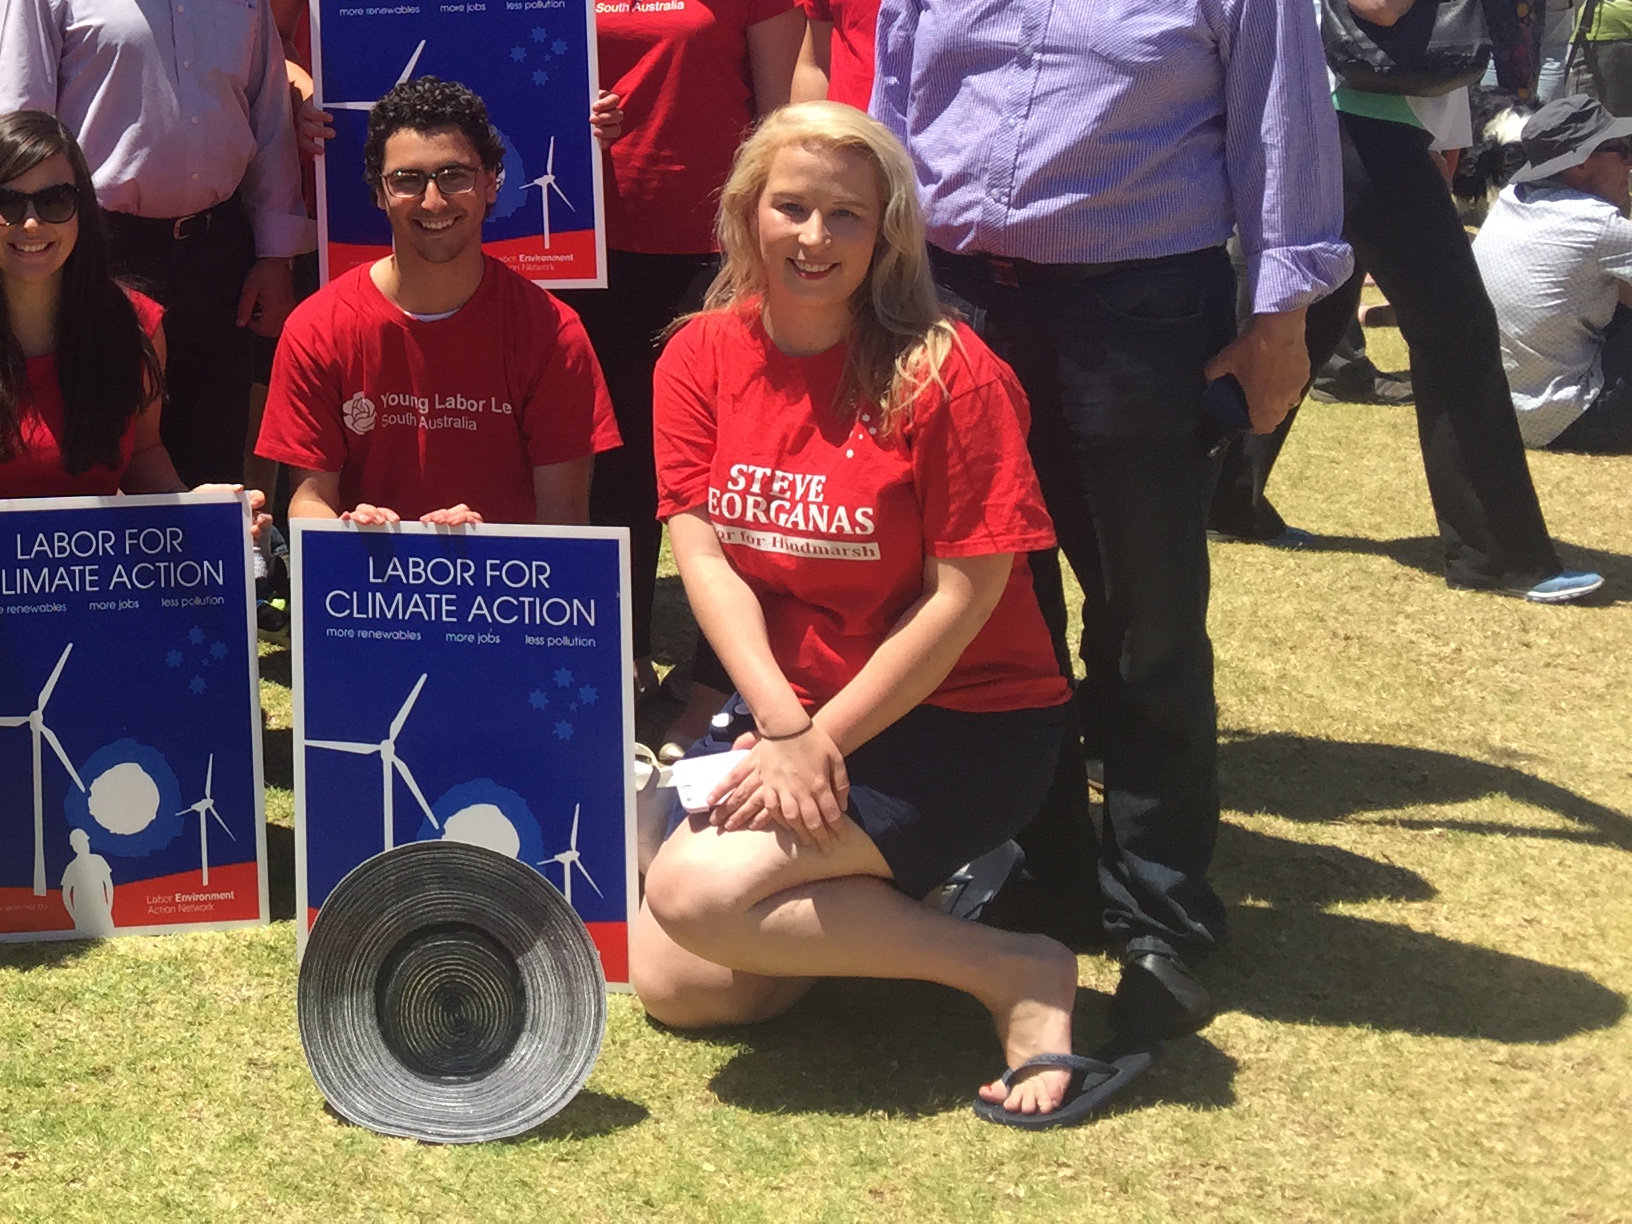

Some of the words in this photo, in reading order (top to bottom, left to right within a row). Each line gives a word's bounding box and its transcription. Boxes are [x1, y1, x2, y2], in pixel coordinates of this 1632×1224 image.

[339, 7, 364, 16] more
[365, 4, 420, 15] renewables
[439, 3, 465, 12] more
[465, 1, 486, 13] jobs
[505, 0, 523, 10] less
[524, 0, 566, 11] pollution
[595, 2, 629, 13] South
[632, 0, 684, 12] Australia
[518, 253, 574, 262] Environment
[381, 392, 429, 414] Young
[435, 394, 486, 413] Labor
[491, 396, 512, 414] Le
[381, 412, 417, 428] South
[419, 415, 477, 431] Australia
[727, 463, 827, 503] STEVE
[708, 486, 875, 535] EORGANAS
[16, 529, 115, 560] LABOR
[124, 527, 183, 555] FOR
[741, 530, 766, 547] for
[771, 536, 876, 558] Hindmarsh
[108, 559, 224, 590] ACTION
[368, 555, 475, 586] LABOR
[485, 559, 551, 589] FOR
[6, 601, 67, 614] renewables
[88, 600, 116, 610] more
[117, 598, 140, 611] jobs
[160, 597, 179, 607] less
[180, 595, 225, 608] pollution
[325, 589, 457, 622] CLIMATE
[467, 594, 595, 627] ACTION
[325, 628, 355, 638] more
[356, 629, 422, 641] renewables
[445, 632, 475, 643] more
[476, 632, 501, 645] jobs
[524, 634, 545, 646] less
[546, 635, 596, 647] pollution
[145, 894, 173, 905] Labor
[174, 890, 235, 903] Environment
[147, 905, 176, 915] Action
[177, 902, 215, 913] Network
